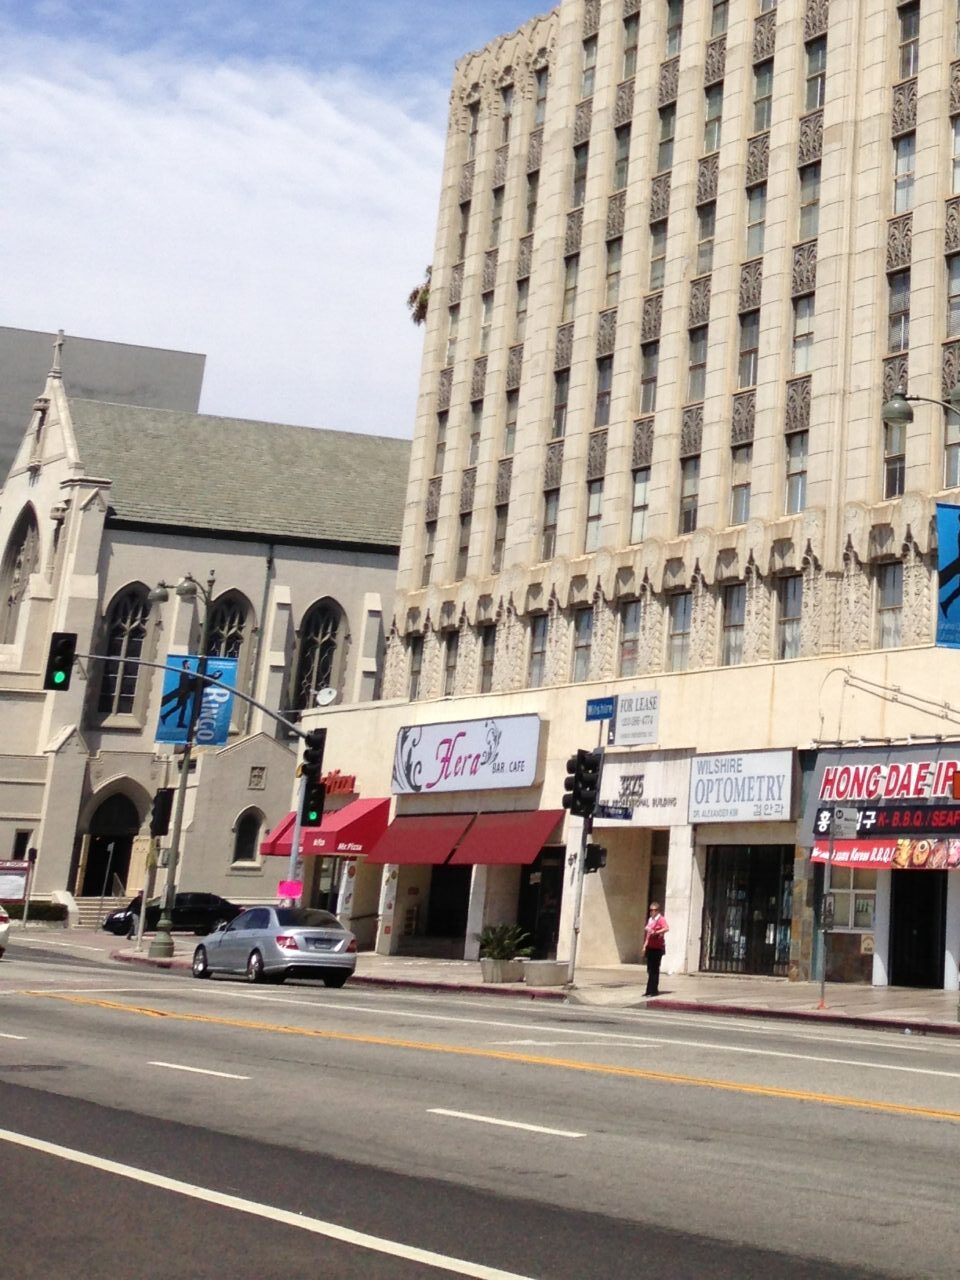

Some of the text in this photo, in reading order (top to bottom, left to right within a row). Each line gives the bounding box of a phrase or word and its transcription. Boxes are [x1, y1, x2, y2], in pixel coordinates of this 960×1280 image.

[197, 687, 230, 740] RINGO
[620, 696, 658, 713] FOR LEASE
[426, 731, 482, 789] Hera
[492, 760, 526, 775] BAR CAFE
[697, 758, 743, 775] WILSHIRE
[695, 775, 786, 805] OPTOMETRY
[819, 766, 882, 801] HONG
[882, 762, 931, 799] DAE
